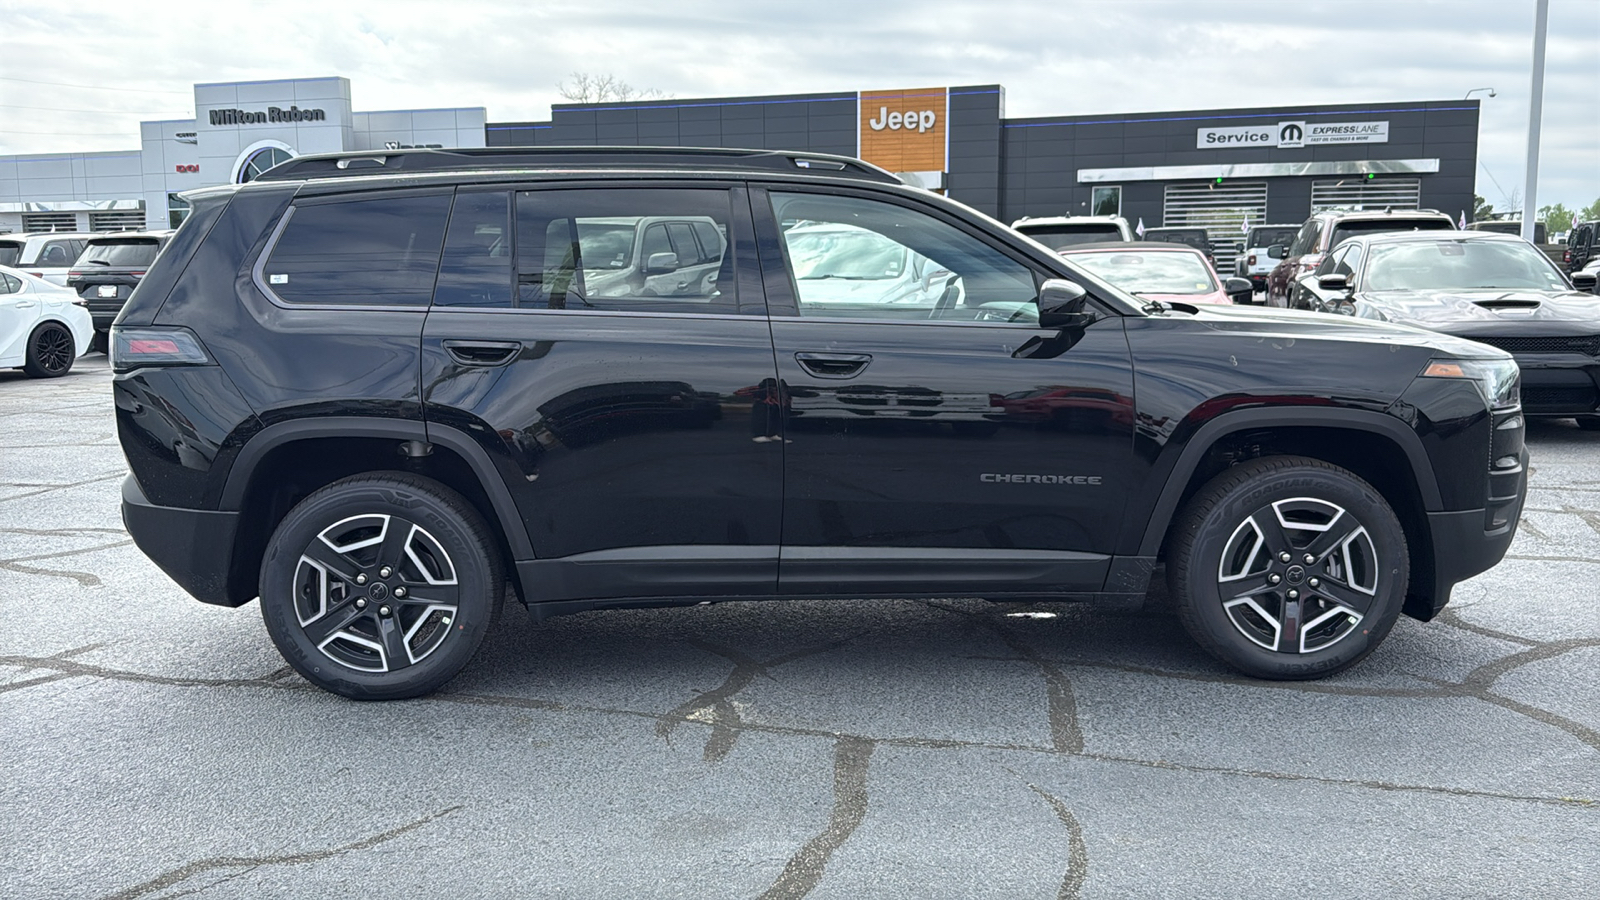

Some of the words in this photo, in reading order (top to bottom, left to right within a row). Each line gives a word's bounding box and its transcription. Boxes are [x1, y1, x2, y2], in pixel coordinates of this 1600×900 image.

[209, 109, 267, 125] Milton
[268, 106, 325, 122] Ruben
[869, 106, 936, 133] Jeep
[1206, 131, 1269, 143] Service
[980, 473, 1102, 485] CHEROKEE
